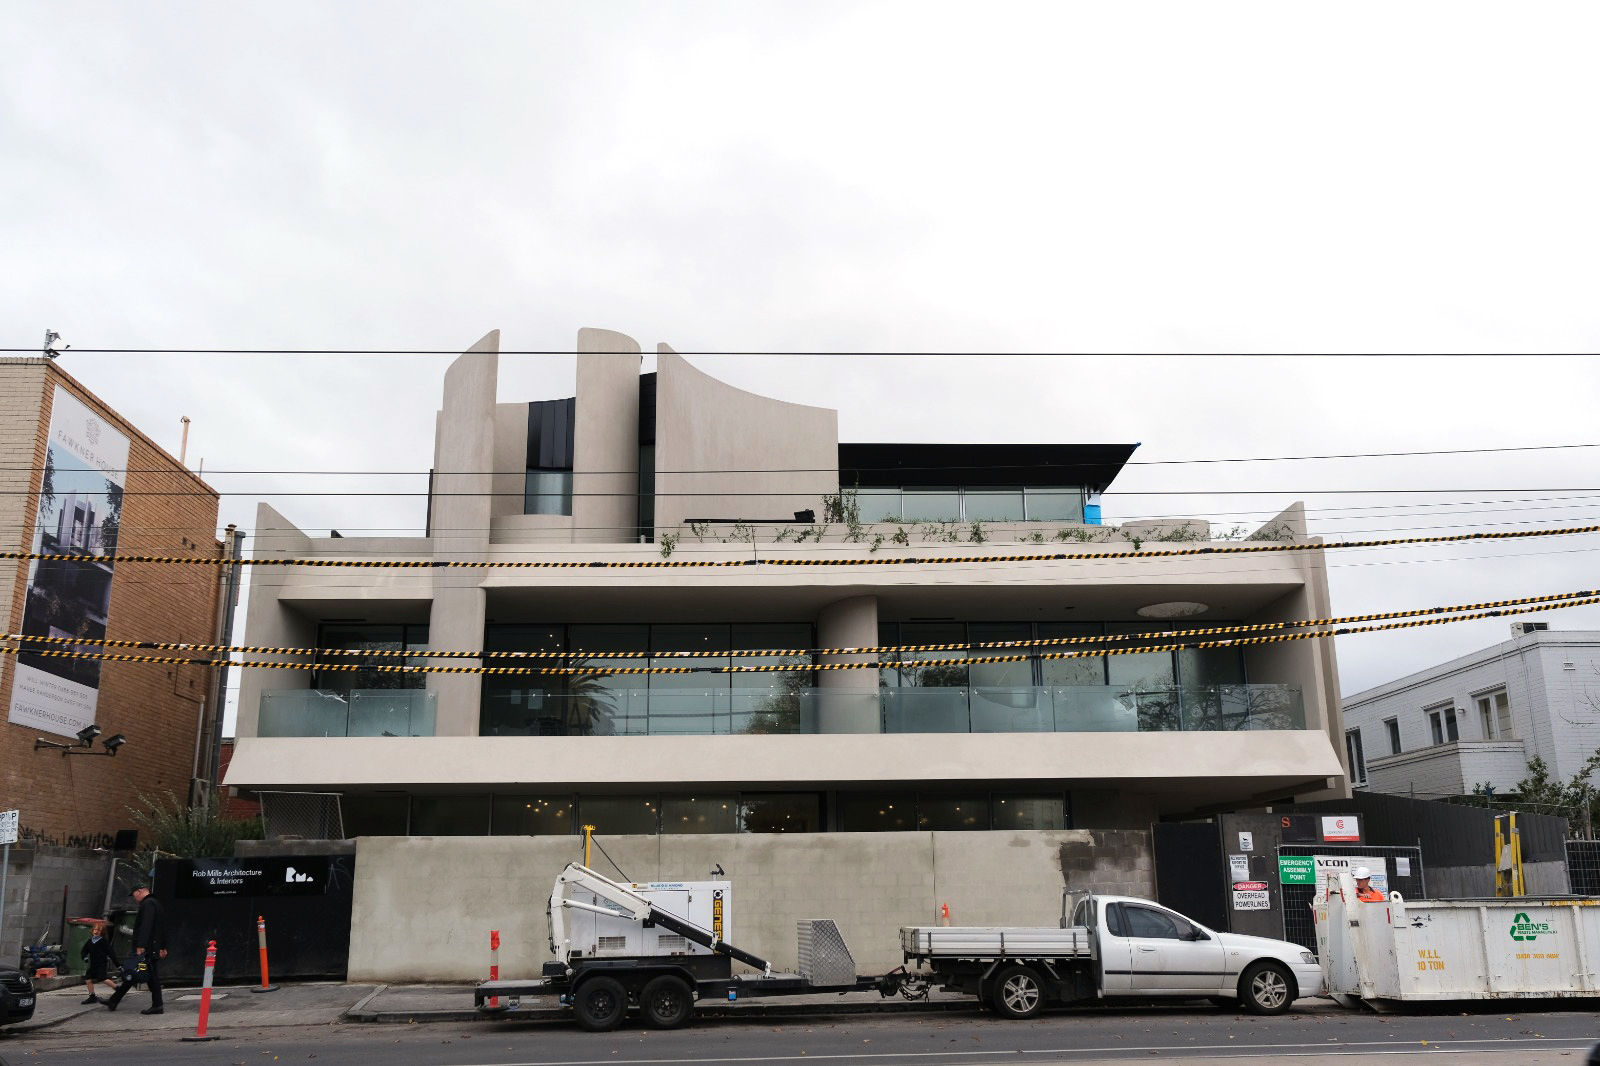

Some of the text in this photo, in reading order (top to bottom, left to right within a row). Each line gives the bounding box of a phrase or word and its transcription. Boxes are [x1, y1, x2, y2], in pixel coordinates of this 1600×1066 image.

[58, 430, 95, 463] FAWKNER
[224, 869, 262, 877] Architecture
[1418, 950, 1440, 959] W.L.L.
[1417, 960, 1444, 970] 10 TON
